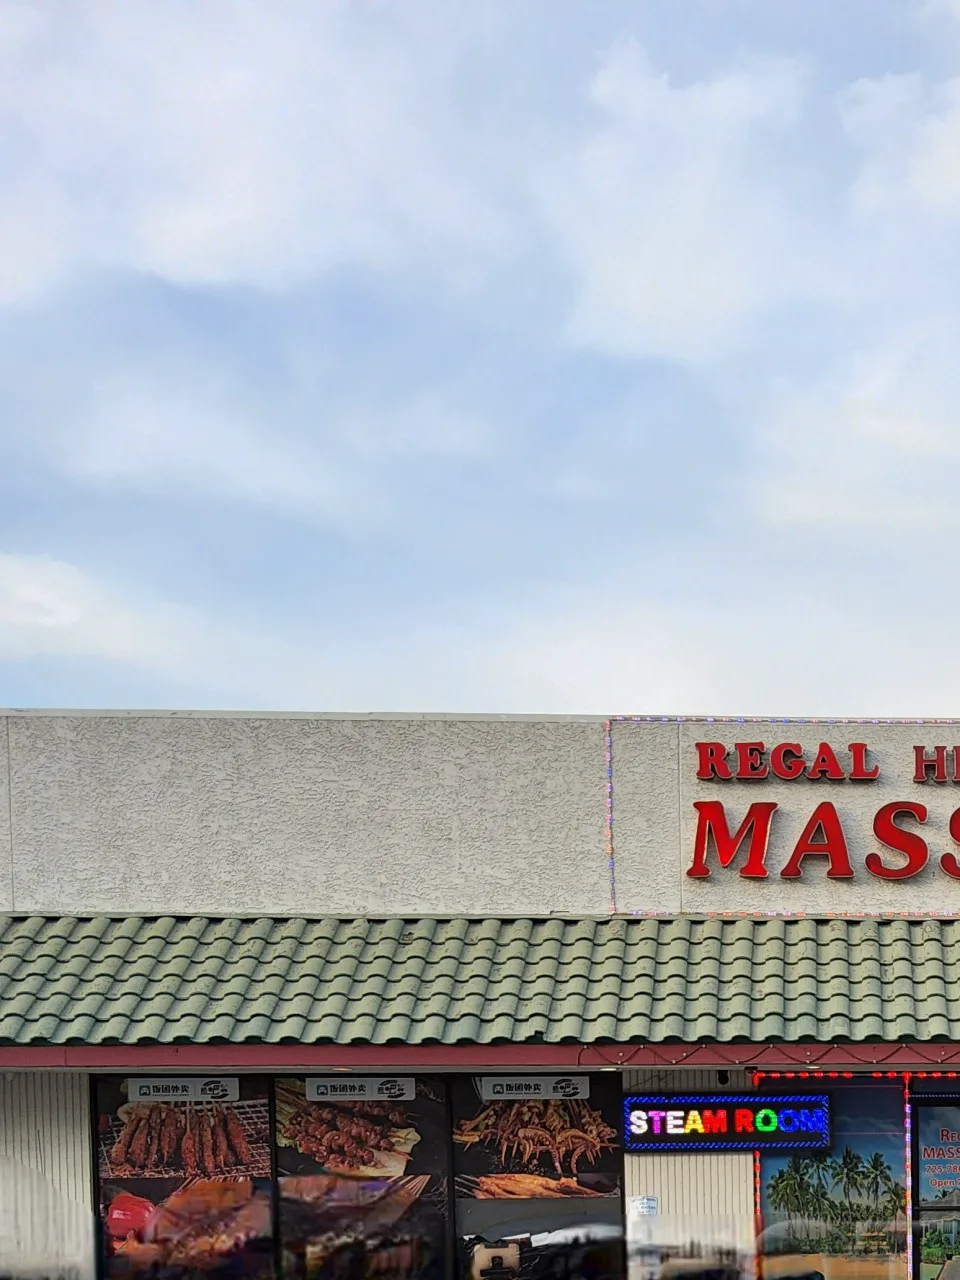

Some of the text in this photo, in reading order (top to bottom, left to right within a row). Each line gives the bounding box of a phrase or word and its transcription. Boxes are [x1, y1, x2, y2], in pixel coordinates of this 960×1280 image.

[696, 742, 880, 780] REGAL
[629, 1108, 824, 1135] STEAM ROOM
[930, 1178, 955, 1188] Open
